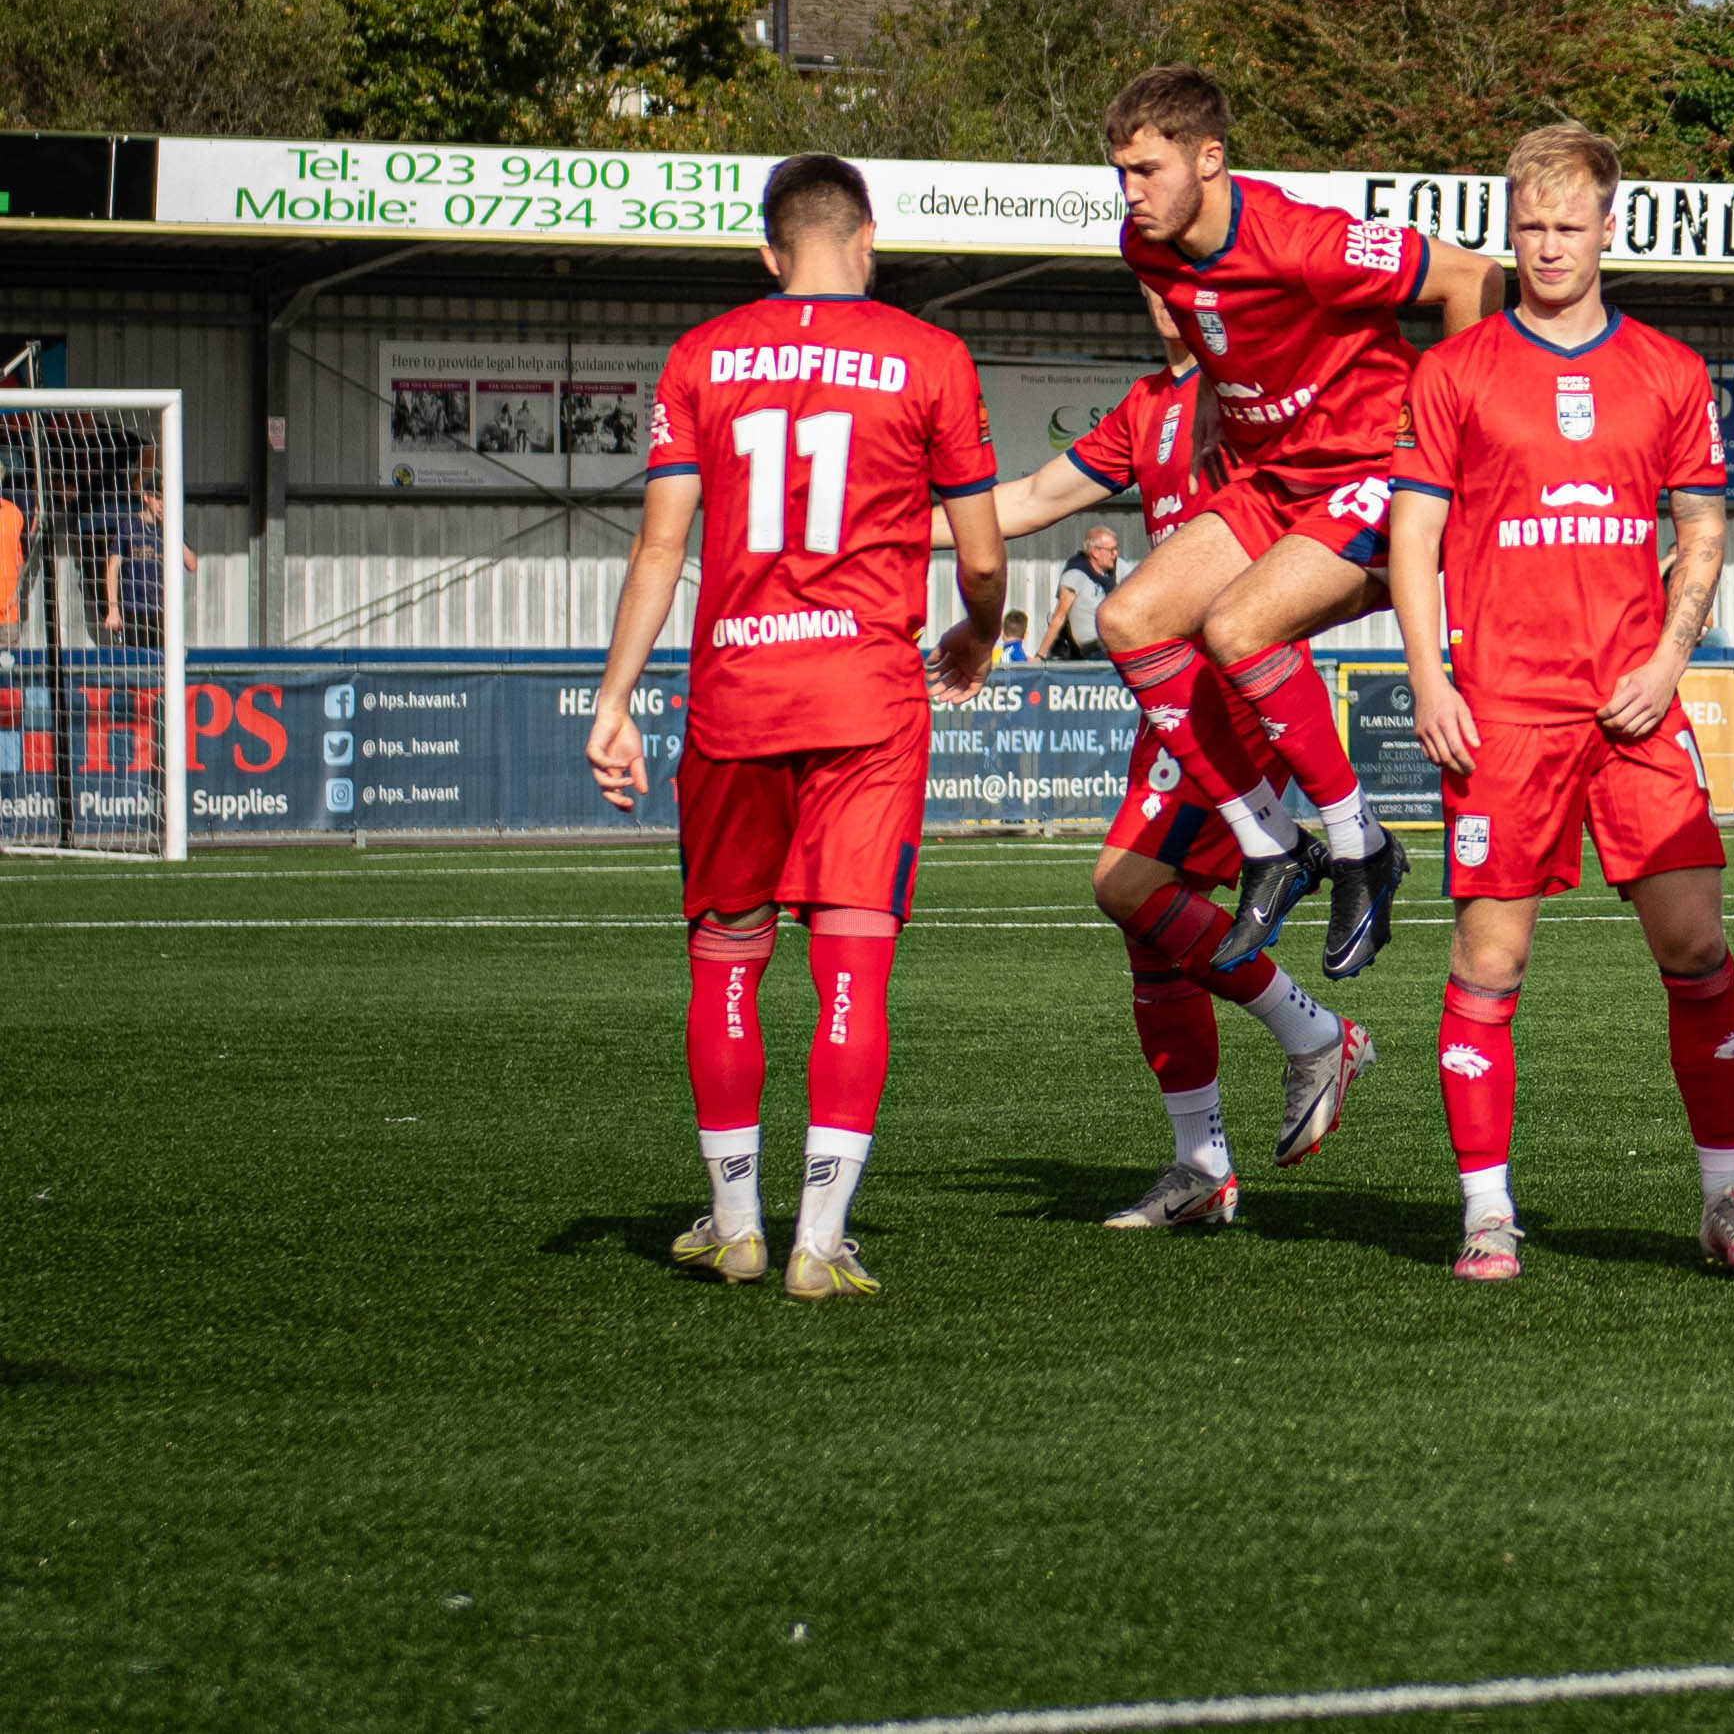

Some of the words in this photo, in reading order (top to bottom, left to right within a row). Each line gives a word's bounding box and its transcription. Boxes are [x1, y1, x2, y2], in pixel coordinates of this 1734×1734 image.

[287, 148, 359, 182] Tel:
[386, 152, 476, 187] 023
[501, 155, 630, 190] 9400
[657, 161, 741, 193] 1311
[235, 186, 417, 225] Mobile:
[444, 194, 597, 229] 07734
[919, 185, 1129, 228] dave.hearn@jssli
[1365, 178, 1512, 250] FOU
[391, 353, 421, 368] Here
[422, 356, 435, 368] to
[437, 354, 485, 372] provide
[486, 354, 515, 373] legal
[518, 354, 544, 373] help
[546, 355, 568, 371] and
[569, 356, 625, 374] guidance
[627, 358, 660, 372] when
[710, 345, 906, 393] DEADFIELD
[732, 409, 853, 555] 11
[1498, 516, 1649, 548] MOVEMBER
[712, 609, 858, 648] UNCOMMON
[559, 687, 664, 716] HENG
[931, 685, 1023, 713] ARES
[1048, 684, 1138, 713] BATHRO
[1682, 701, 1728, 726] PED.
[79, 683, 288, 774] HPS
[1360, 715, 1414, 728] PLATINUM
[929, 729, 991, 757] NTRE,
[996, 729, 1043, 754] NEW
[1050, 730, 1105, 757] LANE,
[1110, 729, 1136, 752] HA
[0, 791, 55, 817] eatin
[79, 790, 165, 817] Plumbi
[192, 788, 289, 821] Supplies
[924, 769, 1128, 806] avant@hpsmercha
[829, 970, 852, 1045] BEAVERS
